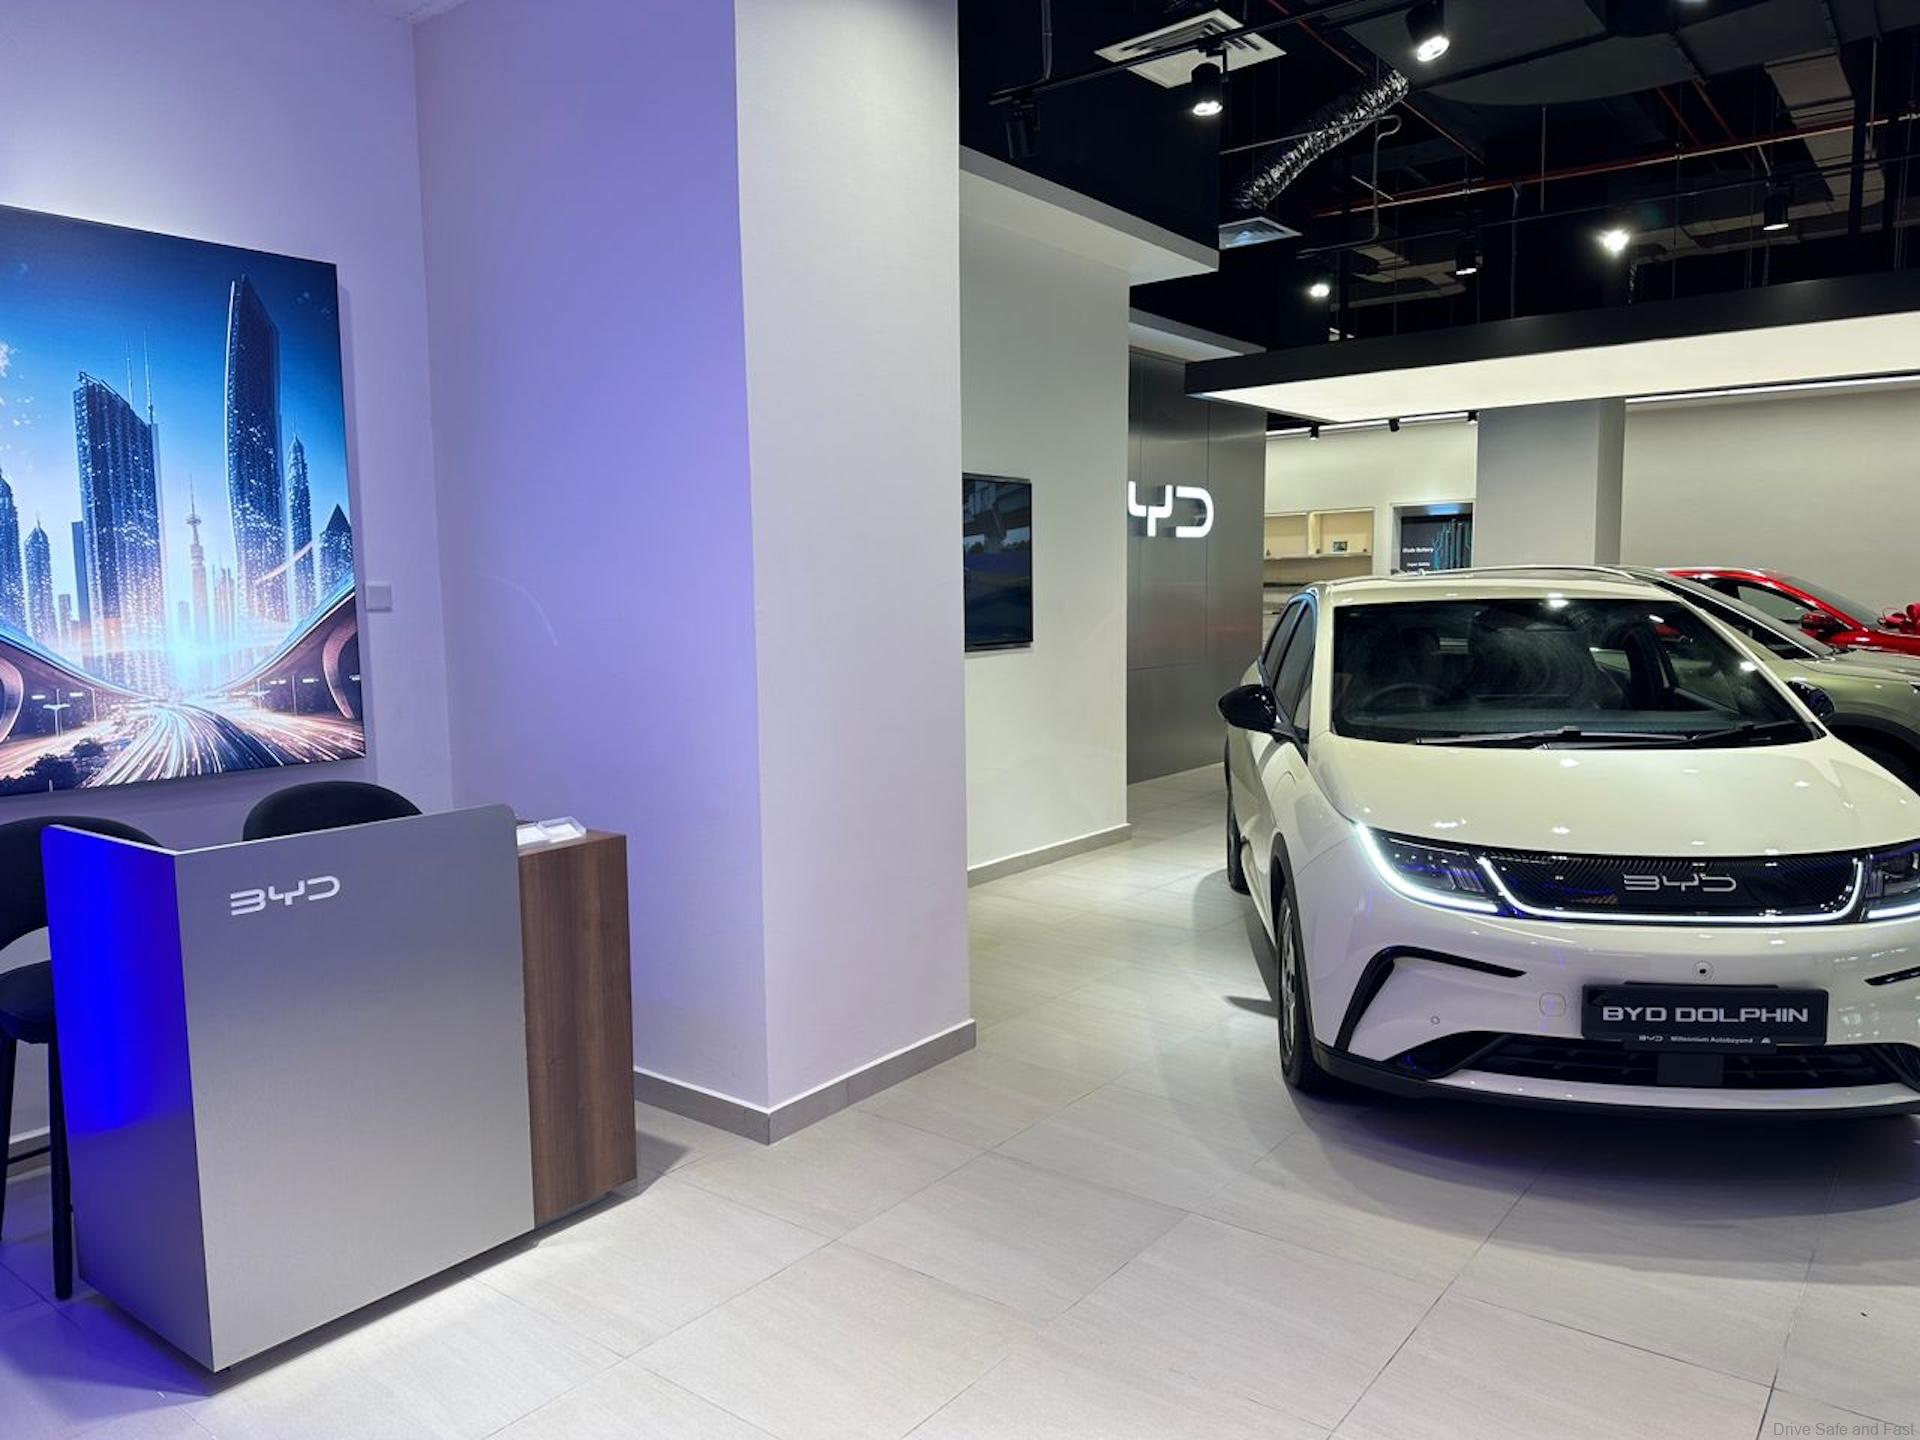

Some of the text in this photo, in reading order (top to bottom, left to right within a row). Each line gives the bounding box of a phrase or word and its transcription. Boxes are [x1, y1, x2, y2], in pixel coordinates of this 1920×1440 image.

[1127, 480, 1215, 538] YD
[230, 875, 341, 916] BYD
[1623, 873, 1737, 892] BYD
[1602, 1006, 1809, 1023] BYD DOLPHIN
